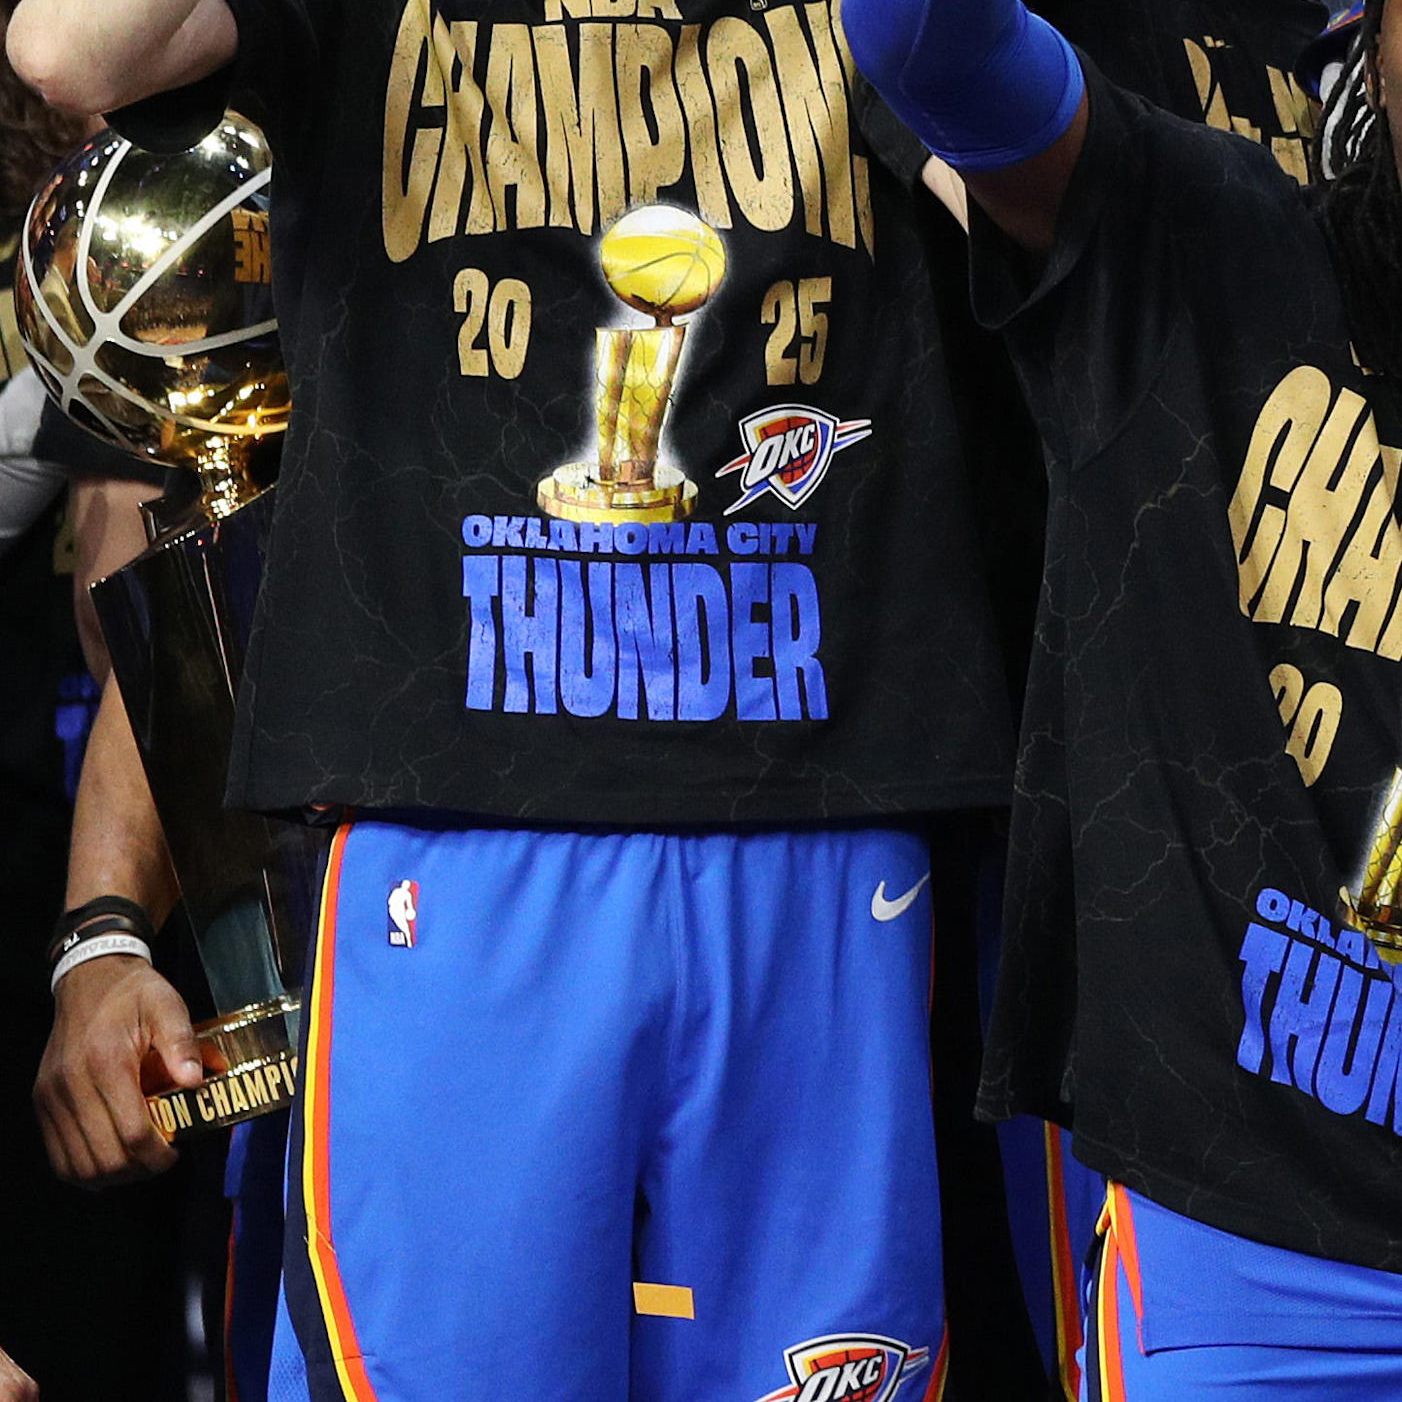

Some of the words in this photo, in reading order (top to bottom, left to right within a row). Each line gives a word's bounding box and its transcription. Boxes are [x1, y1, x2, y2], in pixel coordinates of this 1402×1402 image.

[453, 268, 532, 379] 20
[760, 276, 834, 386] 25
[745, 424, 815, 487] OKC
[462, 513, 719, 555] OKLAHOMA
[727, 521, 818, 555] CITY
[461, 554, 828, 722] THUNDER
[797, 1354, 883, 1402] OKC
